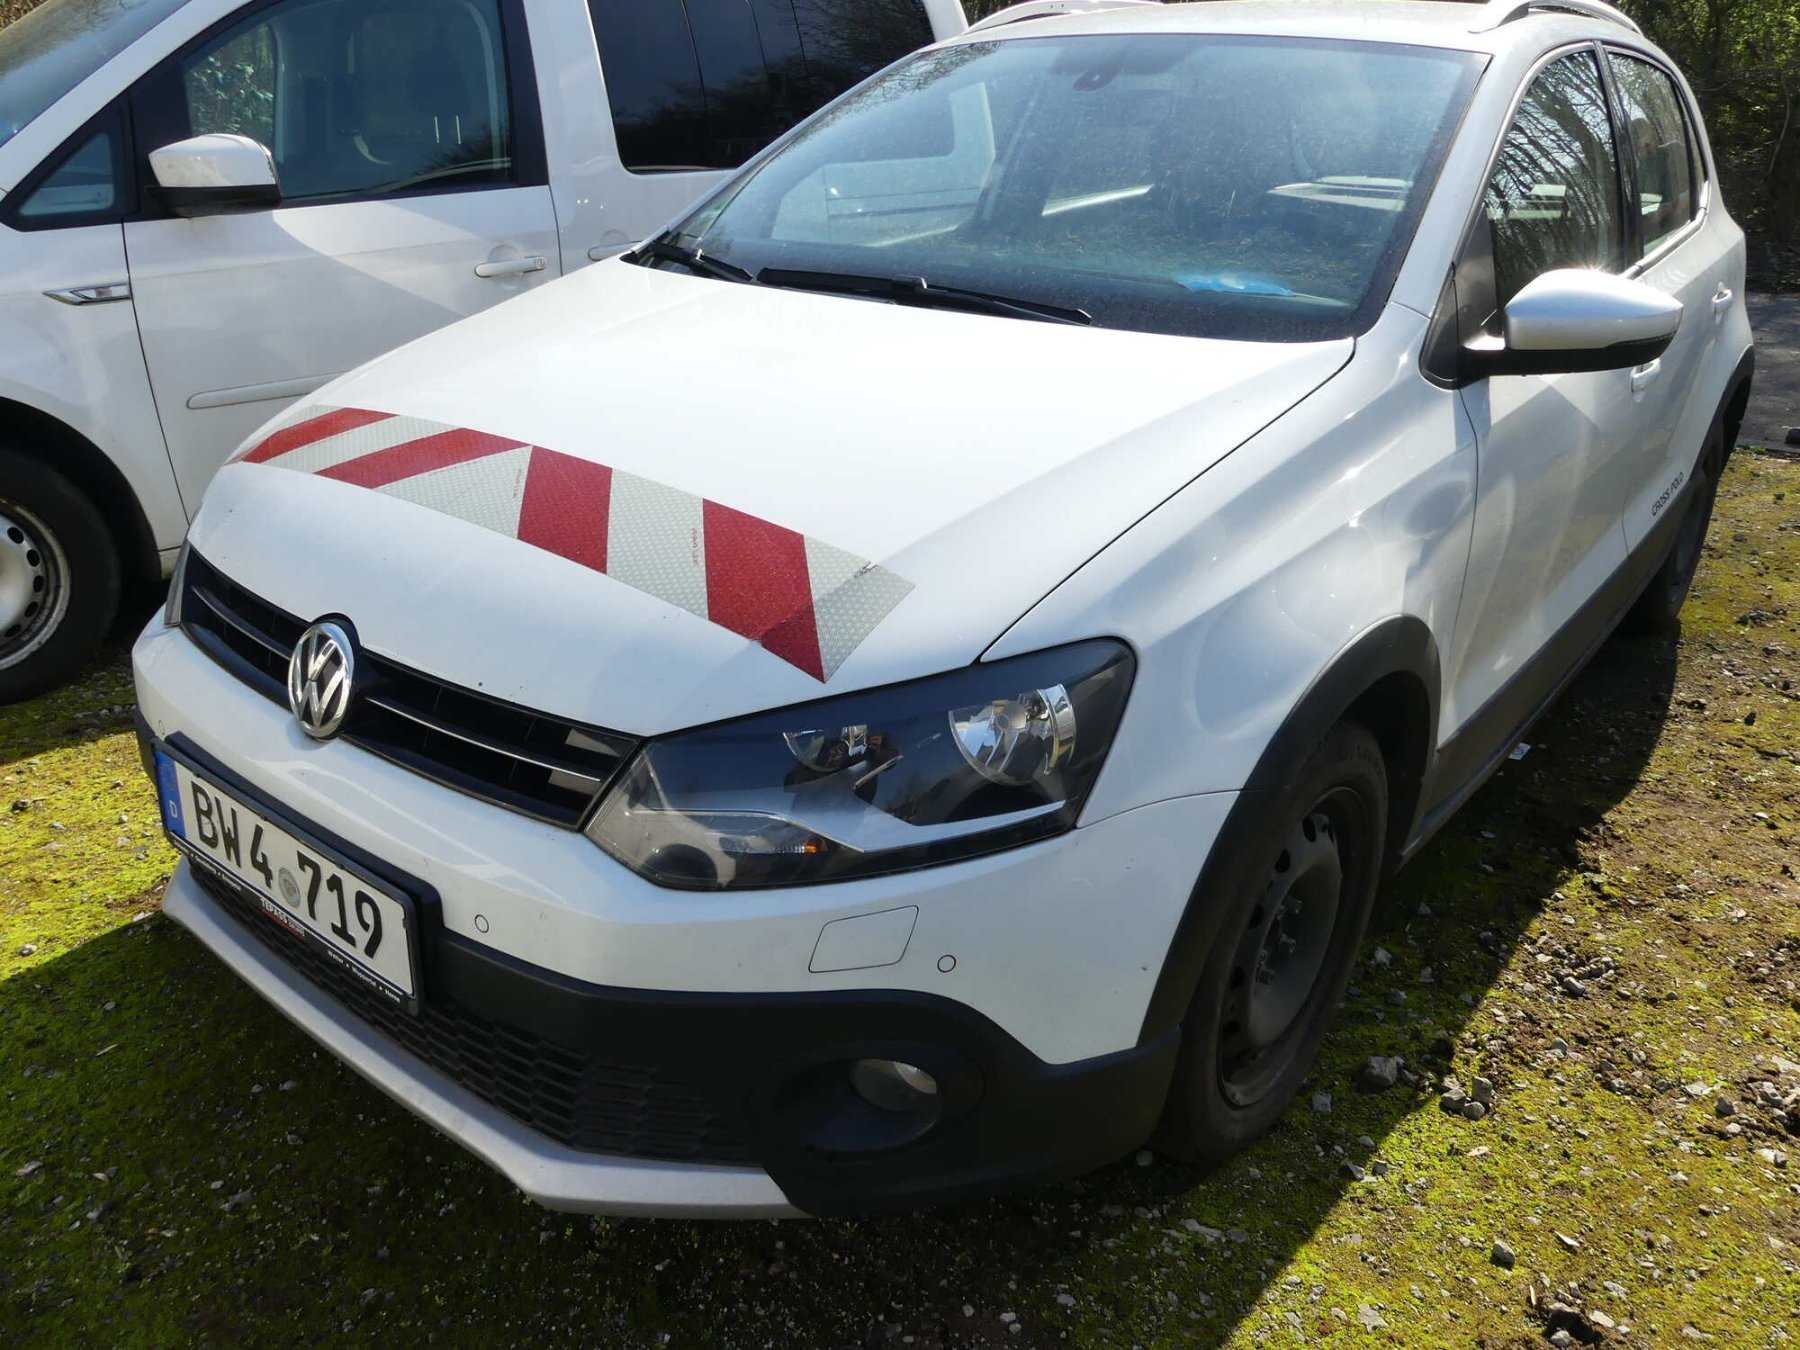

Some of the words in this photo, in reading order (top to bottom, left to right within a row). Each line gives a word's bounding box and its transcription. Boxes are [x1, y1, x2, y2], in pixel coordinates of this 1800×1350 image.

[289, 624, 353, 736] VW
[191, 780, 241, 868] BW
[296, 849, 383, 959] 719
